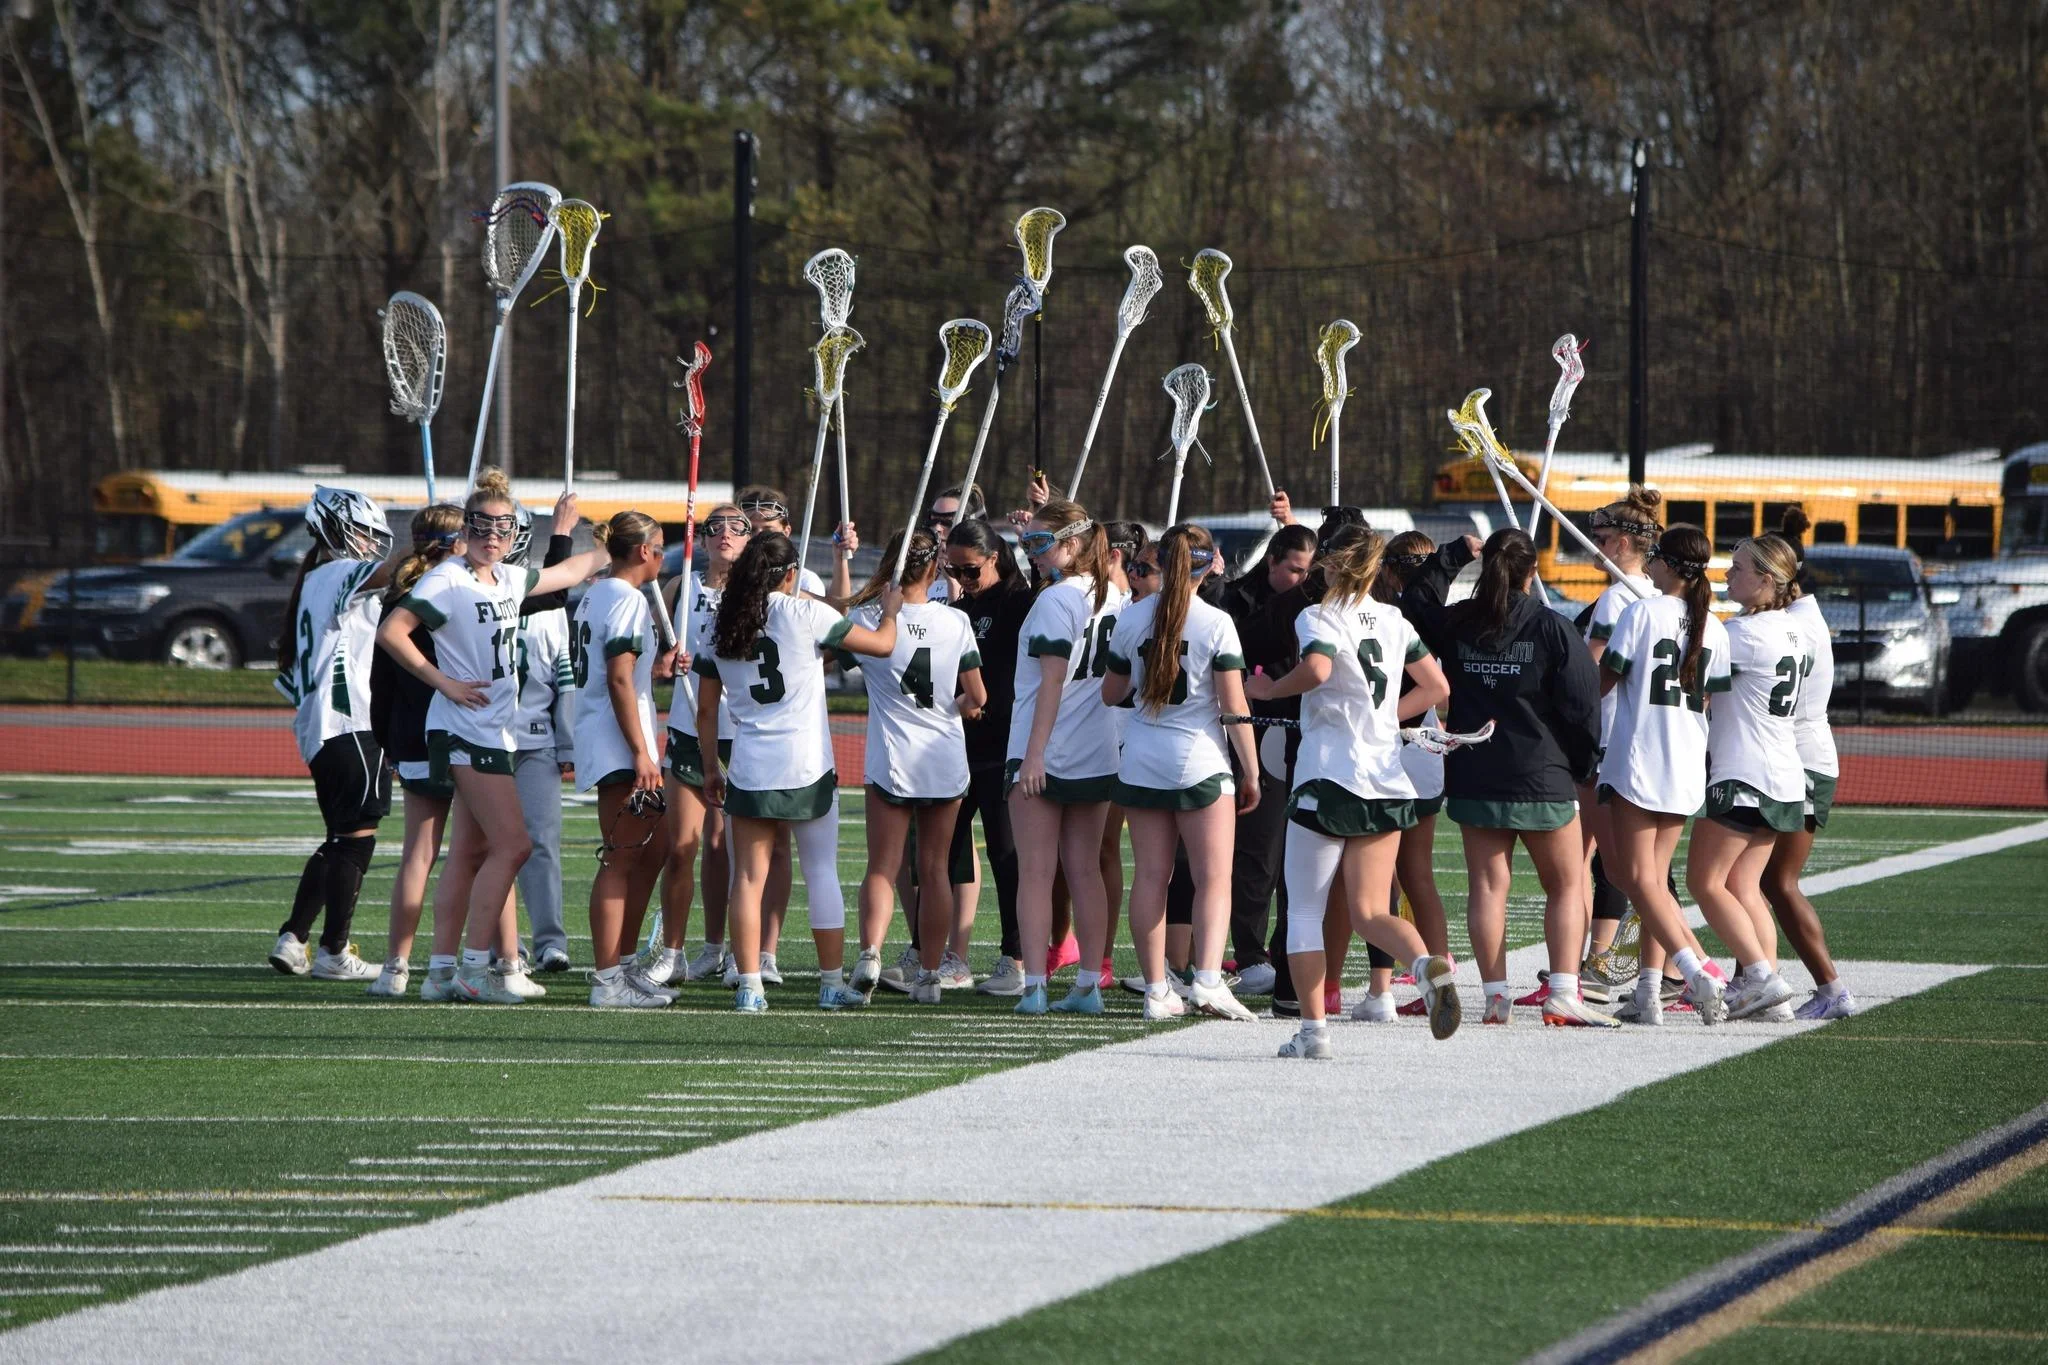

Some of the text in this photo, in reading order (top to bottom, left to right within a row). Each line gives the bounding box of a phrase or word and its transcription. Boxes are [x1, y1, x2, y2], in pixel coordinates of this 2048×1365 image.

[906, 623, 927, 641] WF
[1358, 612, 1377, 631] WF
[490, 626, 517, 682] 17
[747, 634, 786, 705] 3
[899, 647, 934, 709] 4
[1357, 638, 1388, 710] 6
[1463, 662, 1521, 675] SOCCER
[1482, 674, 1498, 689] WF
[1770, 653, 1806, 718] 21
